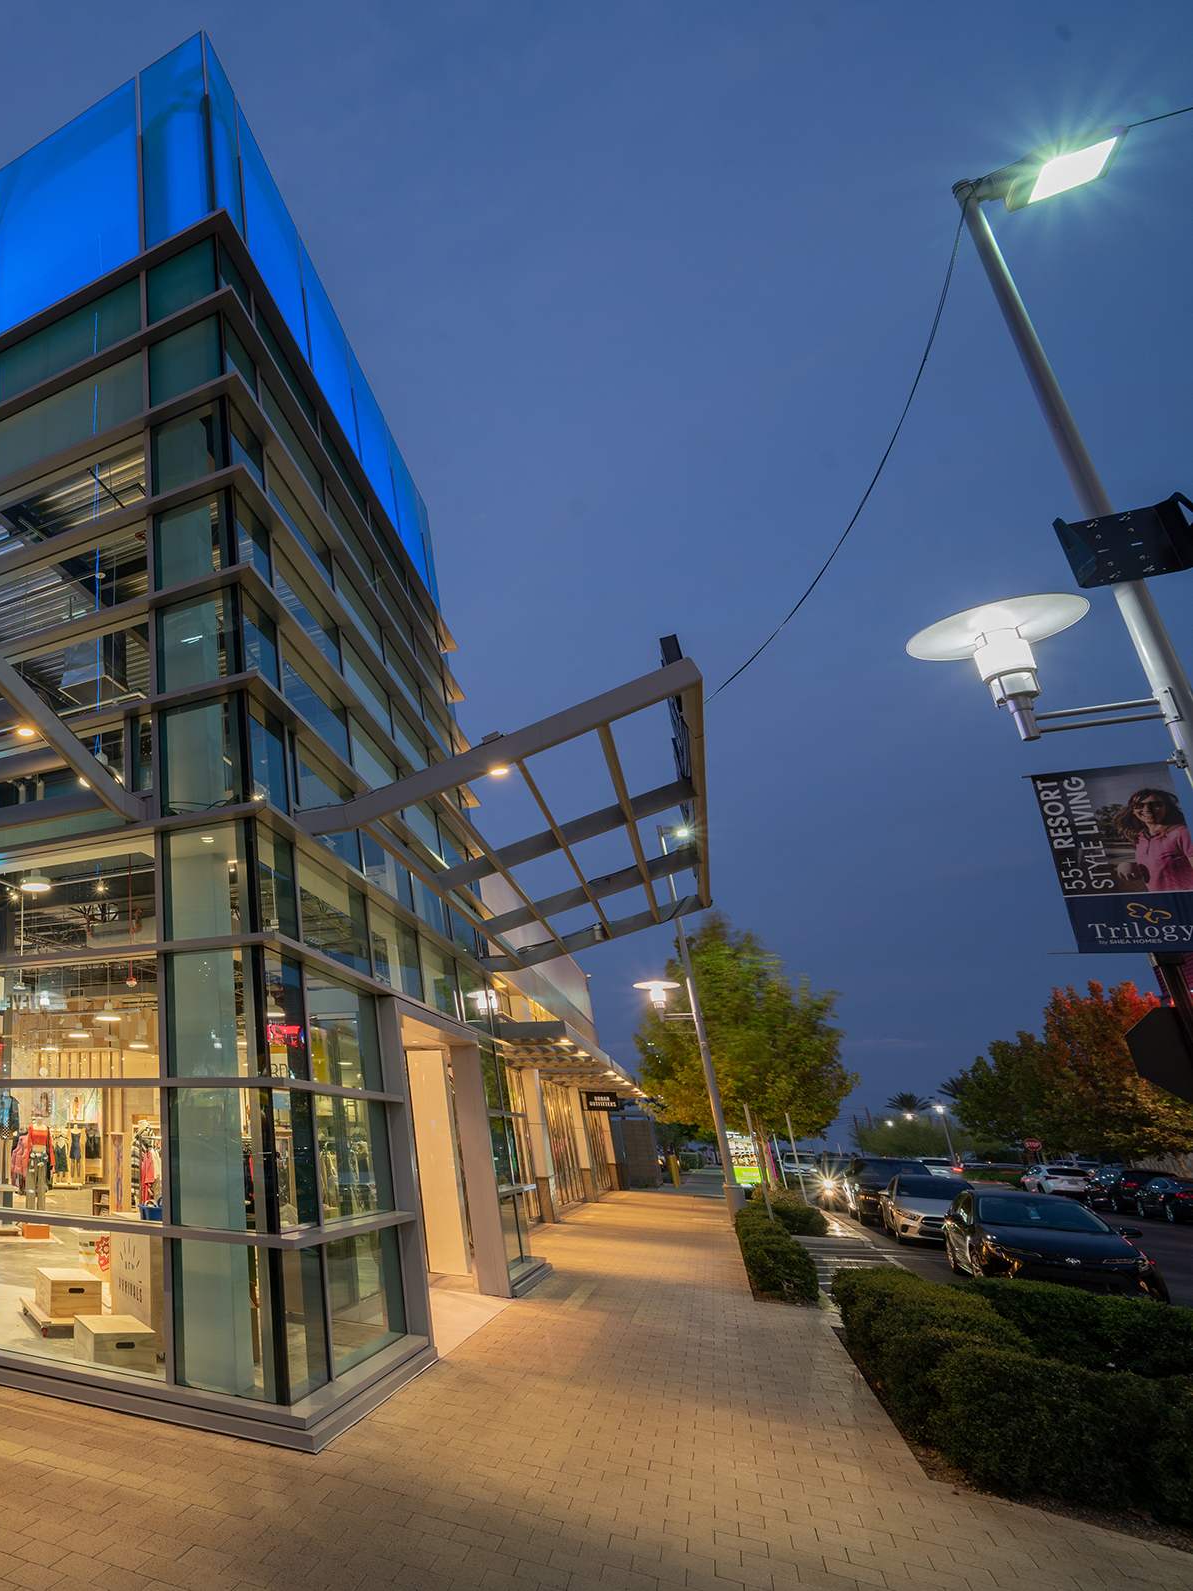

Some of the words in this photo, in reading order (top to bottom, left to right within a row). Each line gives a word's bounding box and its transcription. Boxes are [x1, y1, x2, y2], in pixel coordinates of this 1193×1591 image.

[1037, 780, 1076, 850] RESORT
[1063, 776, 1100, 835] LIVING
[1060, 857, 1087, 890] 55+
[1080, 840, 1115, 889] STYLE
[1087, 921, 1193, 942] Trilogy
